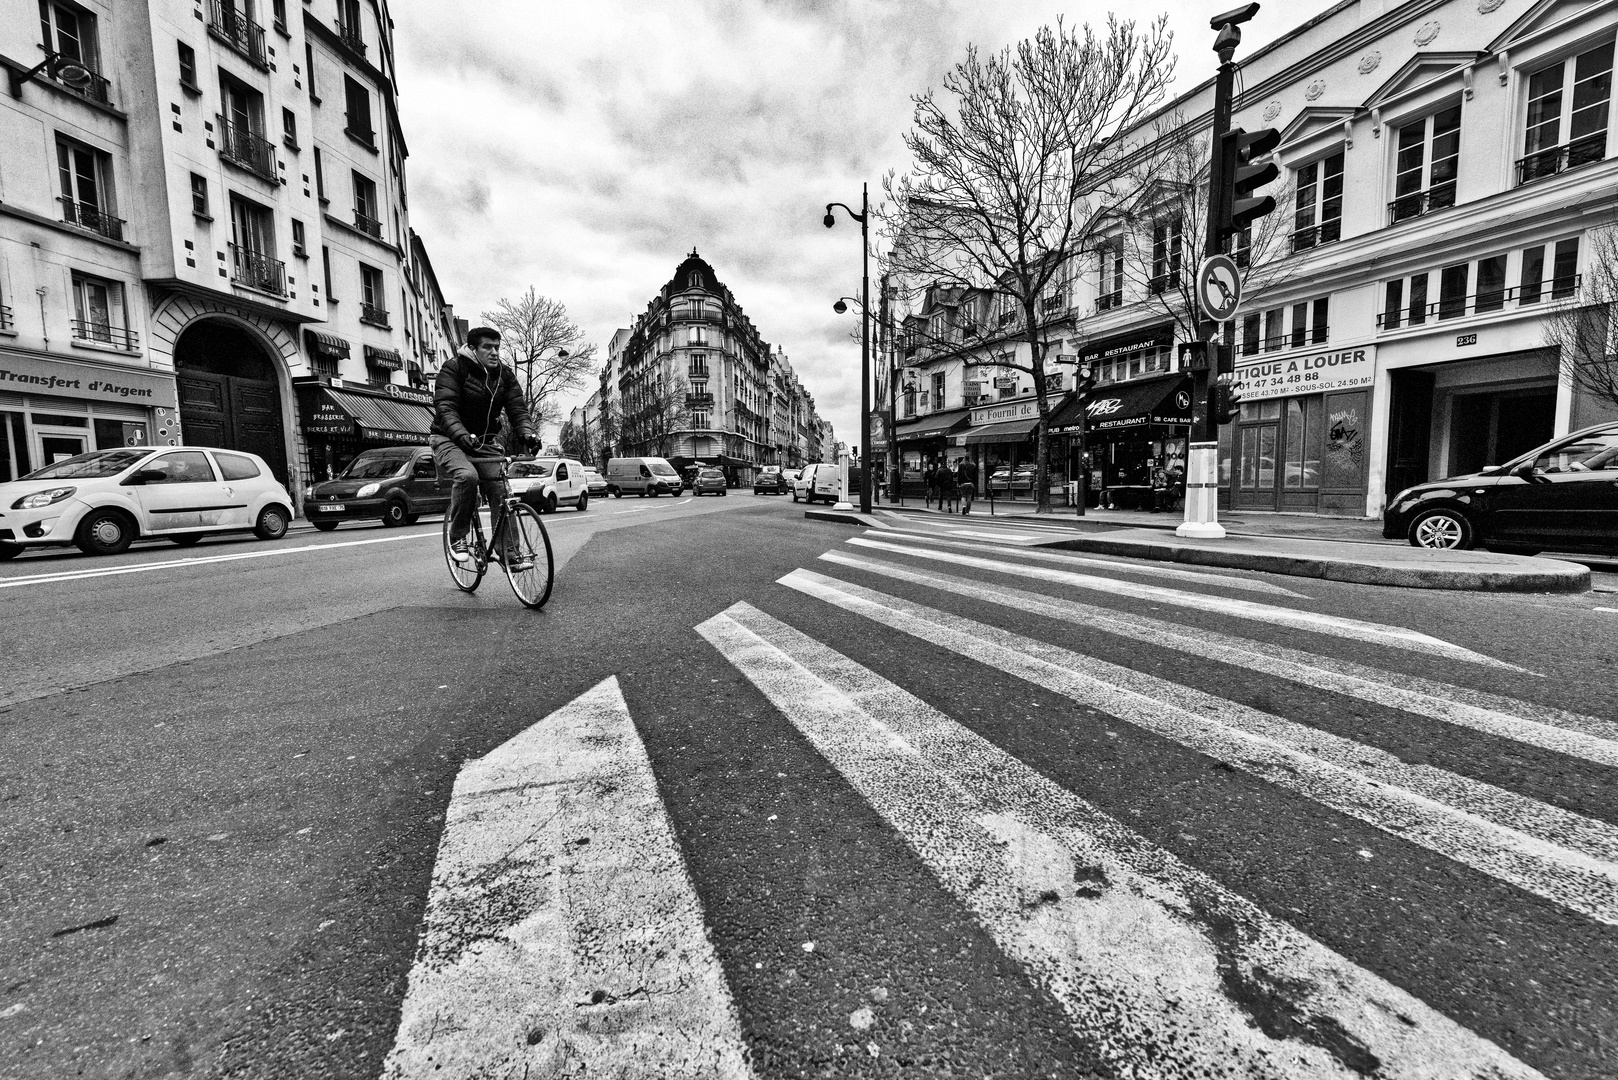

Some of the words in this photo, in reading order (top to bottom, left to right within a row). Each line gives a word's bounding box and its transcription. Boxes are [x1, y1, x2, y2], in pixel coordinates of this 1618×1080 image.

[1457, 335, 1476, 346] 236
[1085, 353, 1099, 361] BAR
[1105, 339, 1155, 357] RESTAURANT
[1287, 361, 1298, 373] A
[1304, 350, 1366, 370] LOUER
[0, 370, 80, 388] Transfert
[88, 381, 153, 397] d'Argent
[1239, 382, 1250, 390] 01
[1254, 380, 1267, 388] 47
[1271, 377, 1284, 386] 34
[1287, 374, 1301, 383] 48
[1305, 372, 1319, 381] 88
[1261, 388, 1278, 397] 43.70
[1295, 382, 1335, 392] SOUS-SOL
[1337, 379, 1358, 387] 24.50
[974, 412, 984, 421] Le
[987, 405, 1017, 419] Fournil
[1020, 404, 1032, 415] de
[1099, 417, 1147, 428] RESTAURANT
